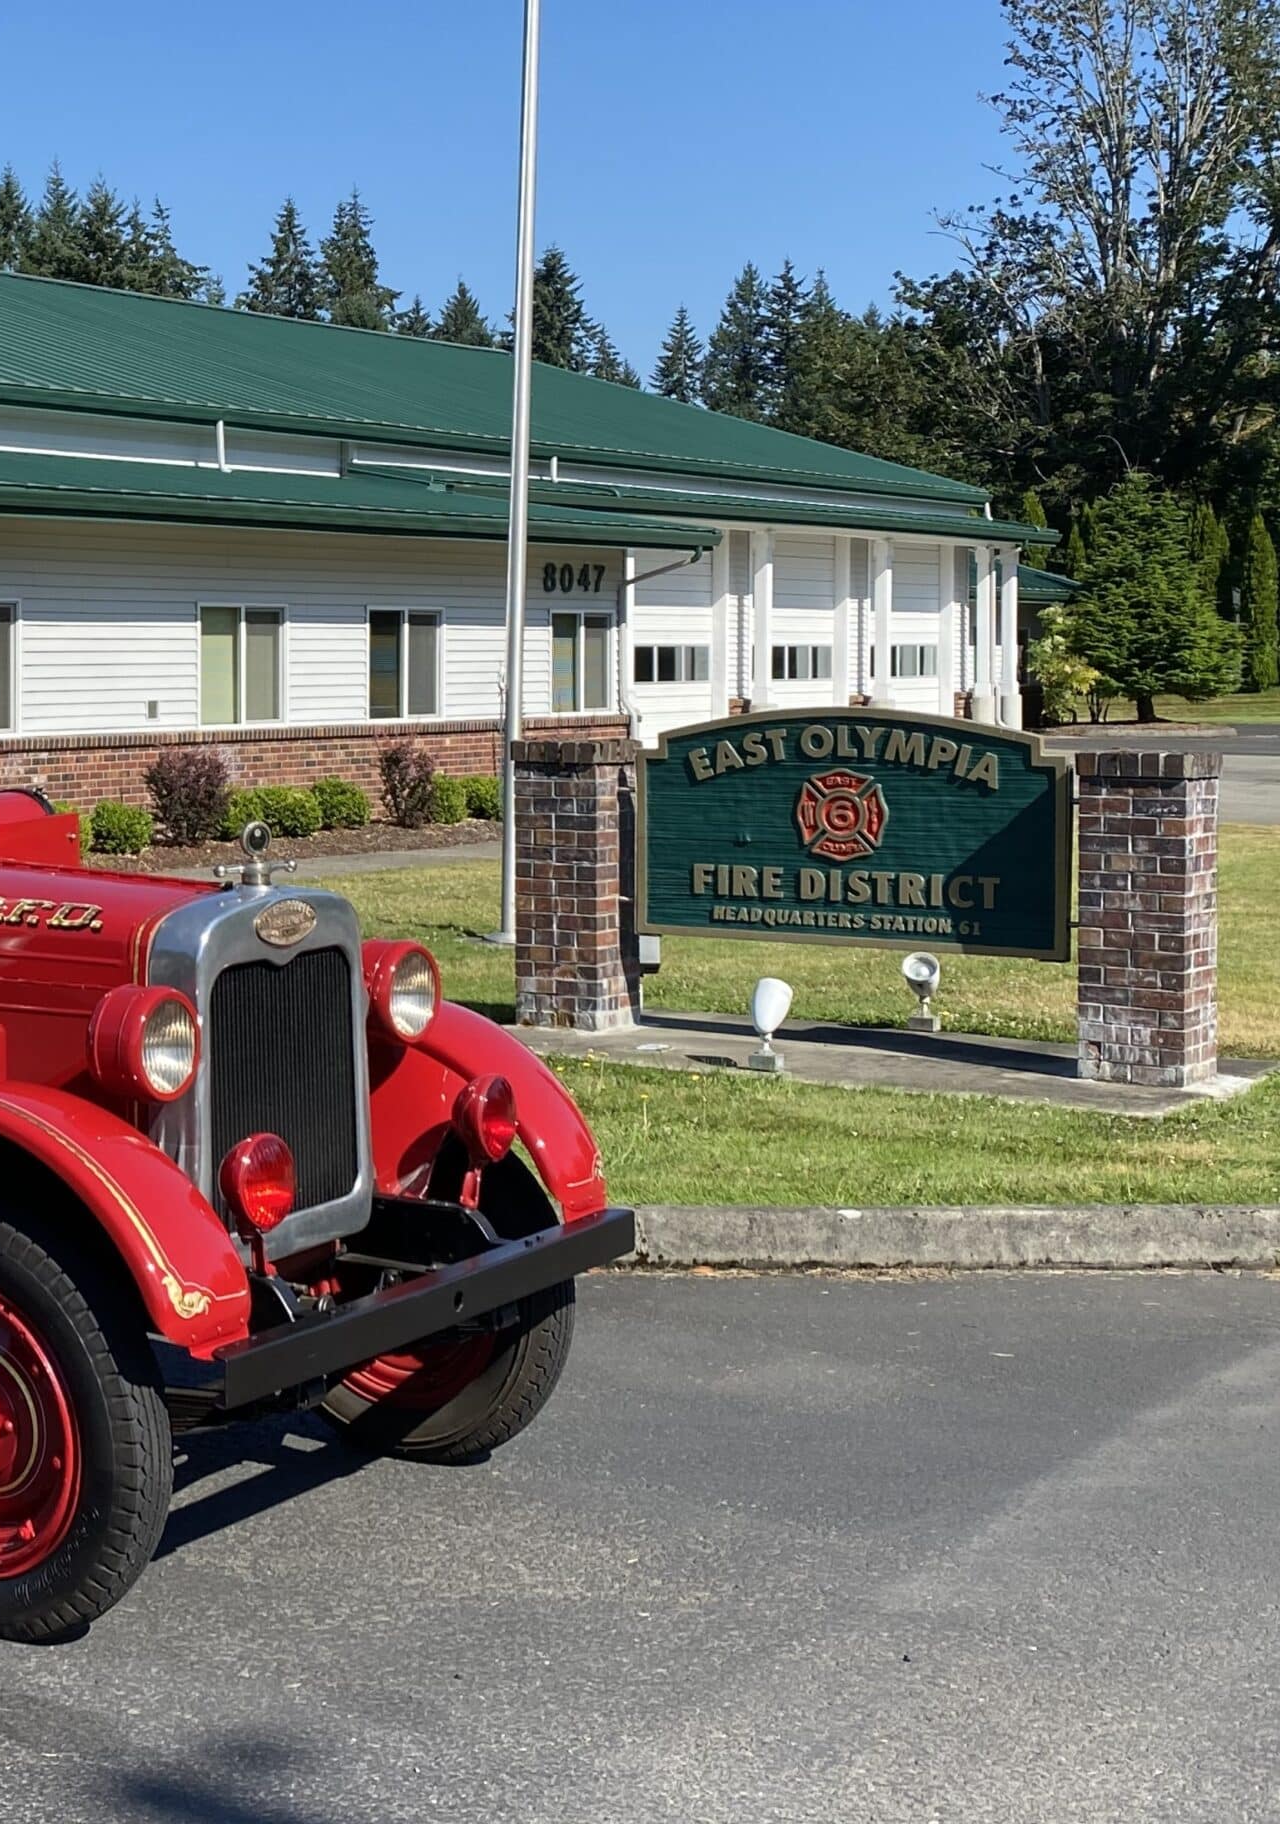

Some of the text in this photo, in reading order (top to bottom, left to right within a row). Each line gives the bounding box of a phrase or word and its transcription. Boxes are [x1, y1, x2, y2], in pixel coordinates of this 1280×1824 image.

[543, 562, 606, 593] 8047
[689, 724, 1000, 790] EAST OLYMPIA
[830, 800, 856, 828] 6
[693, 864, 1001, 910] FIRE DISTRICT
[713, 905, 982, 936] HEADQUARTERS STATION 61
